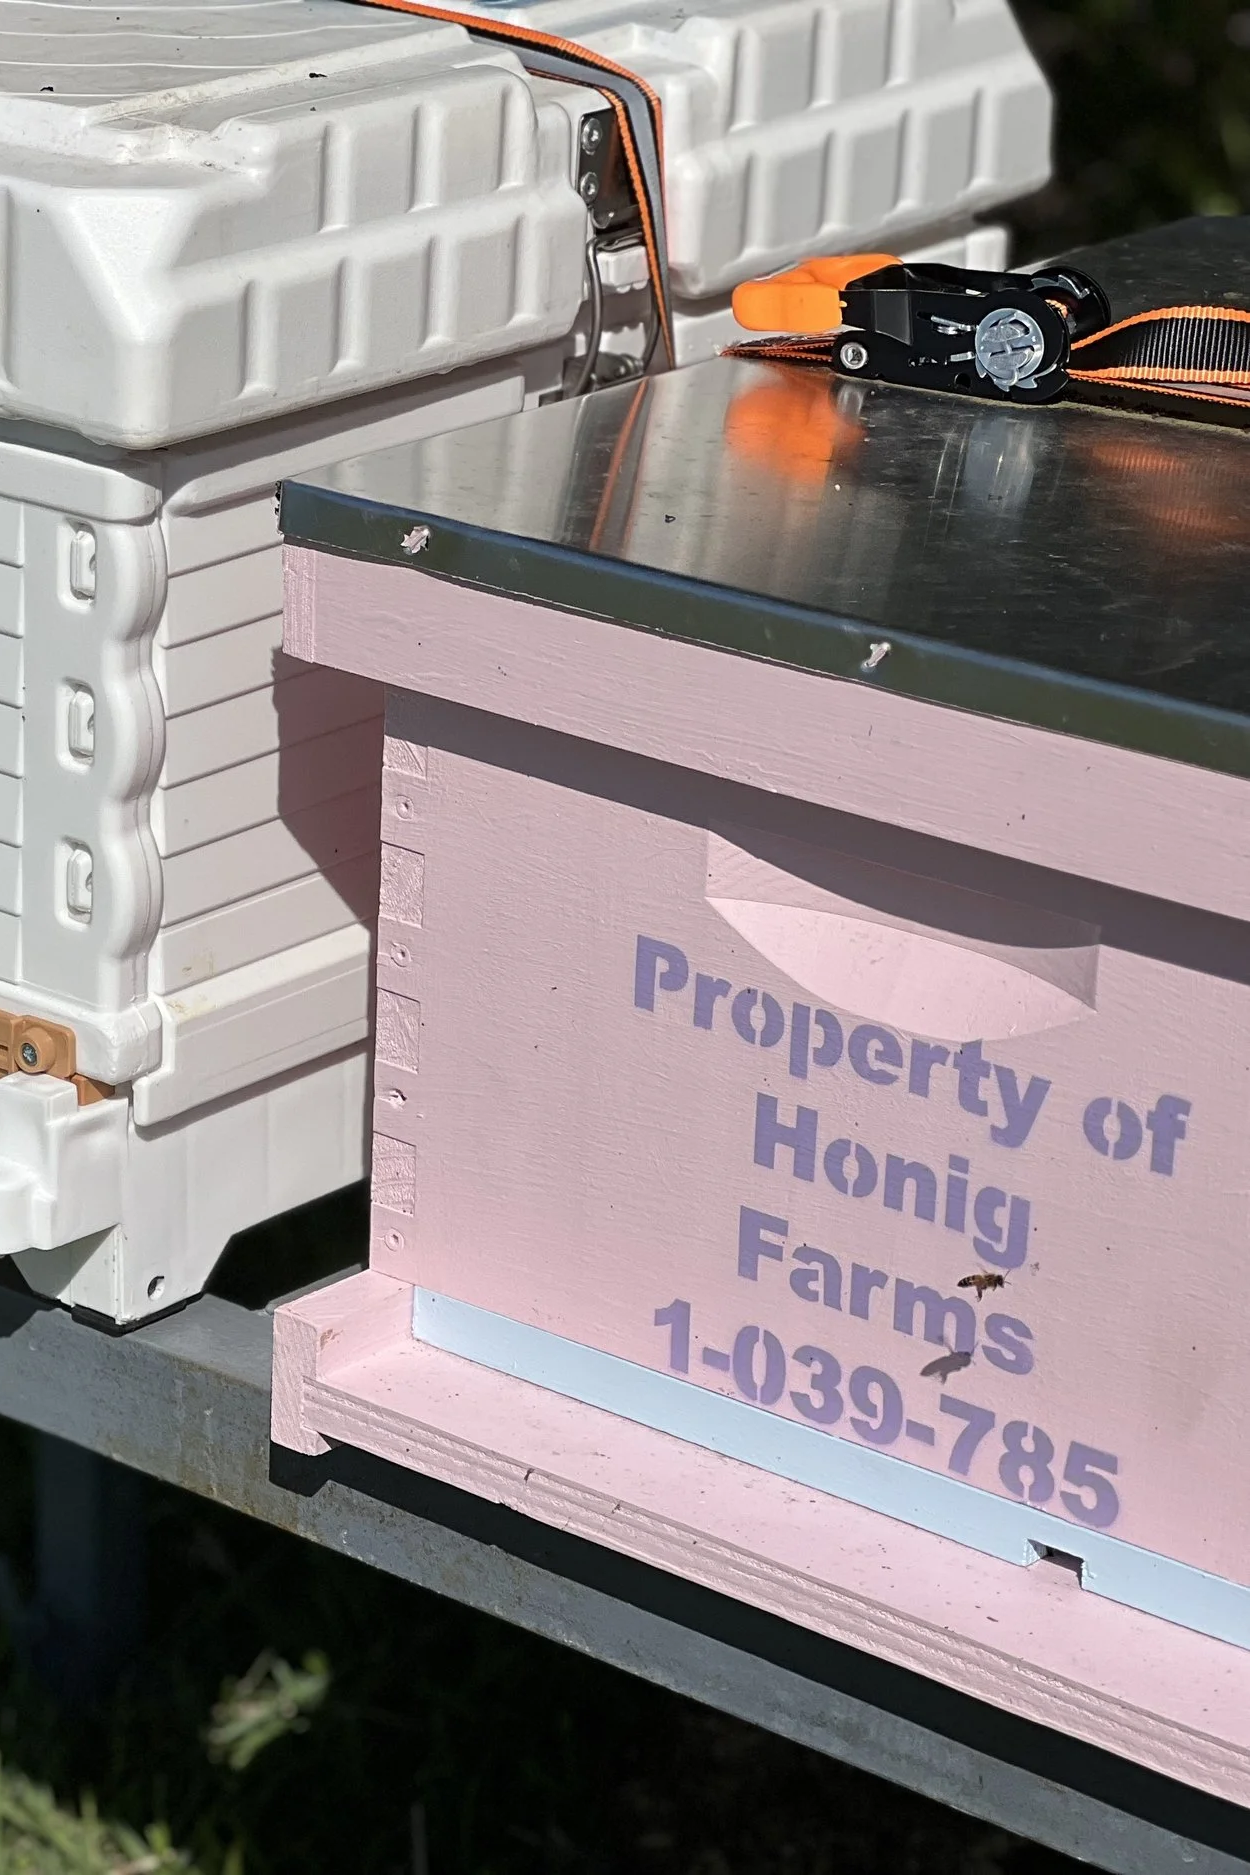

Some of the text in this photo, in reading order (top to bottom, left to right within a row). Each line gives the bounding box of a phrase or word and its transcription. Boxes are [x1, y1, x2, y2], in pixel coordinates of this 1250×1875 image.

[634, 934, 1192, 1176] Property of
[753, 1092, 1031, 1269] Honig
[738, 1205, 1035, 1376] Farms
[654, 1299, 1120, 1528] 1-039-785
